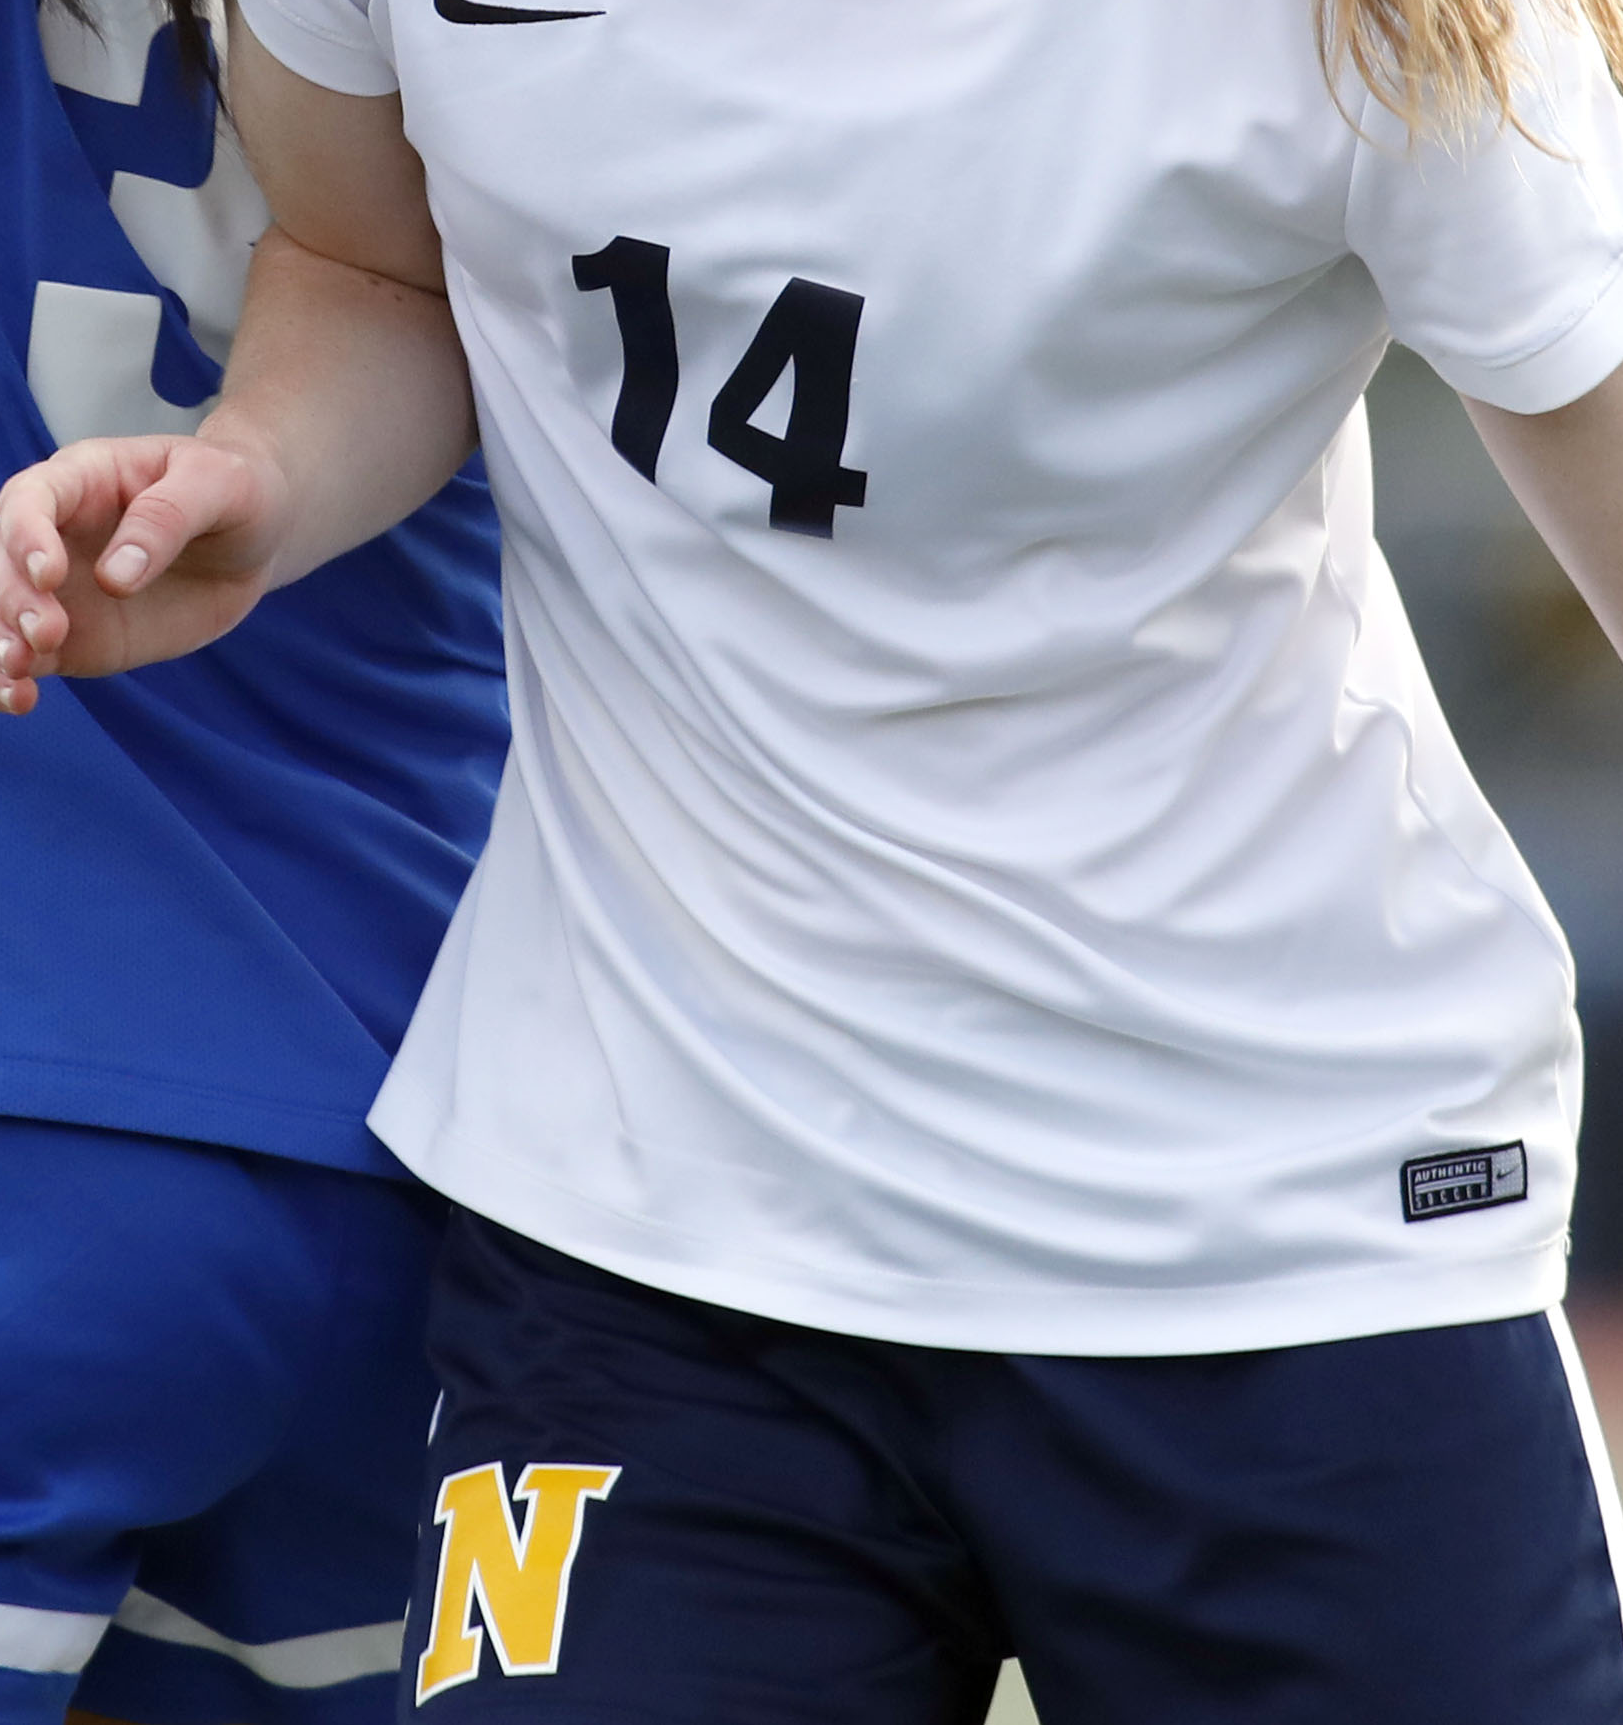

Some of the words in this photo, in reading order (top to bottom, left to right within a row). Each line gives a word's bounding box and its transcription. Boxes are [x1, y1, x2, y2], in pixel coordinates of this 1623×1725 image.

[572, 236, 867, 539] 14
[1414, 1161, 1486, 1183] AUTHENTIC
[1416, 1184, 1487, 1209] SOCCER
[415, 1462, 622, 1706] N
